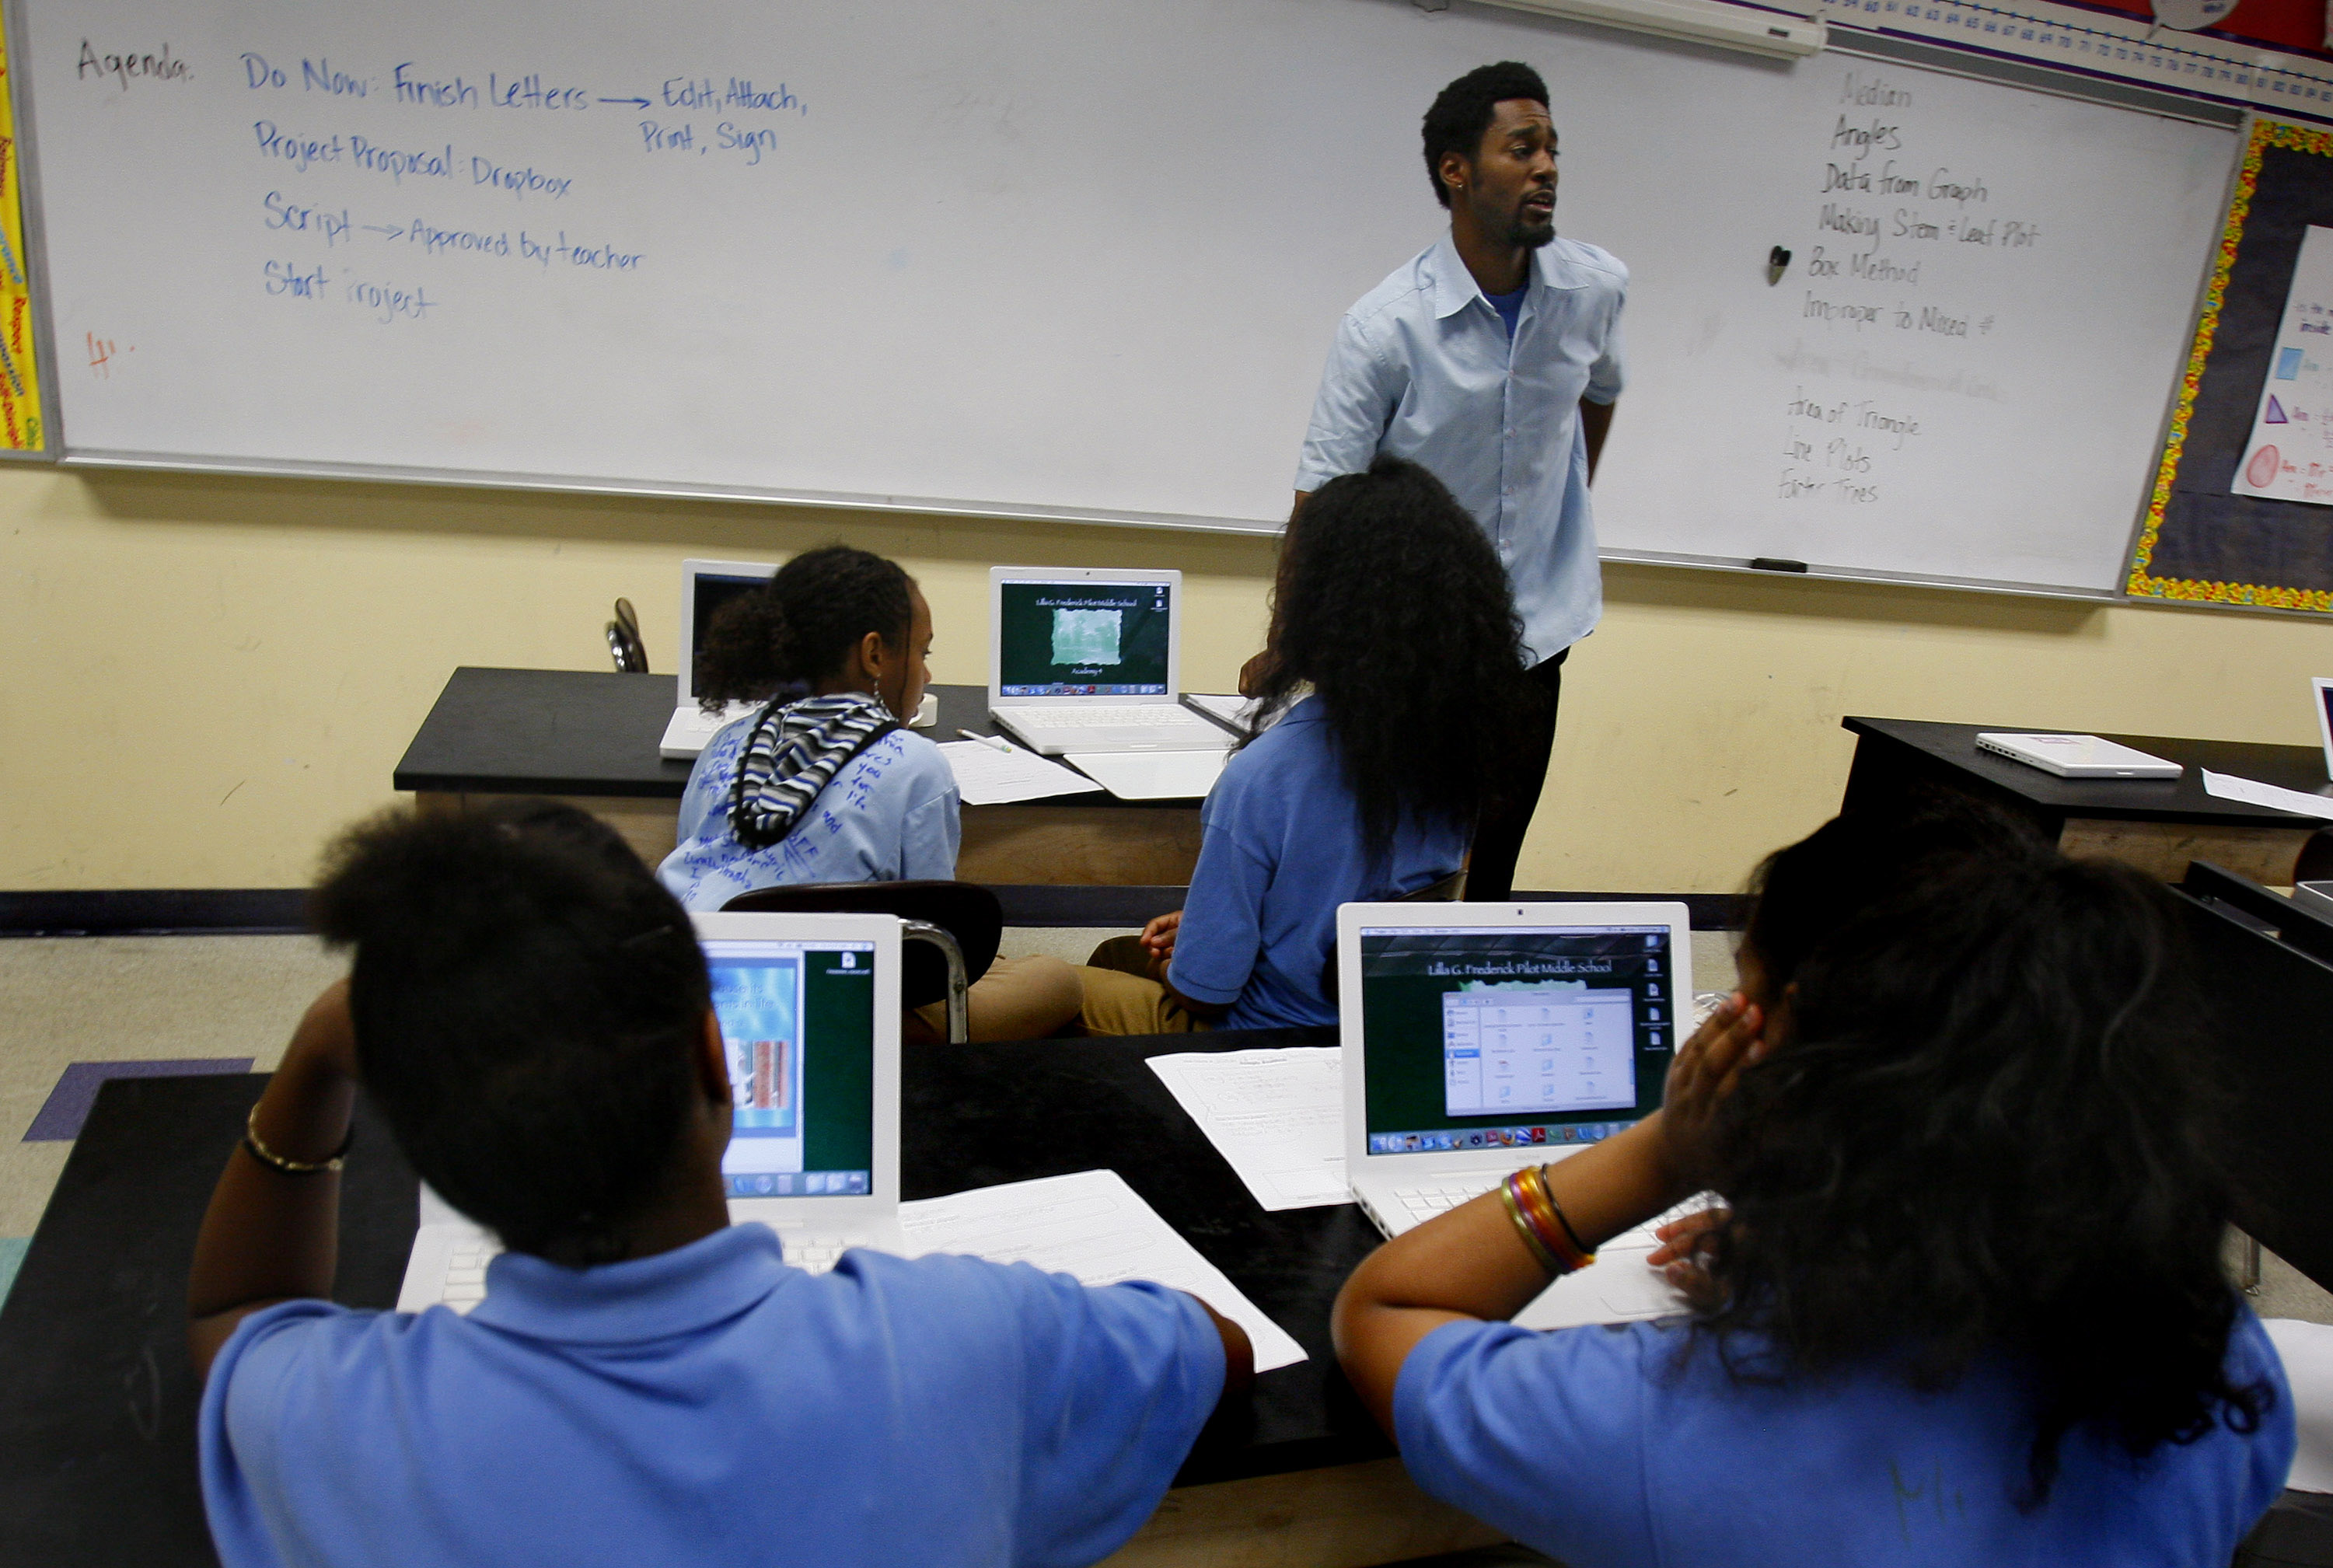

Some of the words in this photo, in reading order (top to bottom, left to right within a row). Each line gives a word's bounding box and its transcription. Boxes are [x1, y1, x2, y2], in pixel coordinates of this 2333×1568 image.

[240, 52, 287, 89] Do
[393, 61, 478, 110] Finish
[490, 73, 589, 111] Letters
[661, 76, 721, 114] Edit,
[726, 76, 807, 117] Attach,
[253, 119, 343, 173] Project
[472, 155, 572, 200] Dropbox
[716, 121, 777, 166] Sign
[1831, 113, 1902, 160] Angles
[1821, 162, 1870, 193] Data
[1878, 159, 1920, 196] from
[1929, 167, 1988, 209] Graph
[264, 190, 353, 247] Script
[408, 218, 509, 254] Approved
[520, 231, 550, 268] by
[554, 231, 646, 269] teacher
[264, 260, 330, 299] Start
[1809, 246, 1839, 278] Box
[1828, 402, 1848, 423] of
[1854, 400, 1922, 451] Triangle
[1427, 962, 1450, 976] Lilla
[1451, 963, 1464, 976] G.
[1517, 959, 1539, 974] Pilot
[1542, 959, 1576, 973] Middle
[1577, 959, 1612, 973] School
